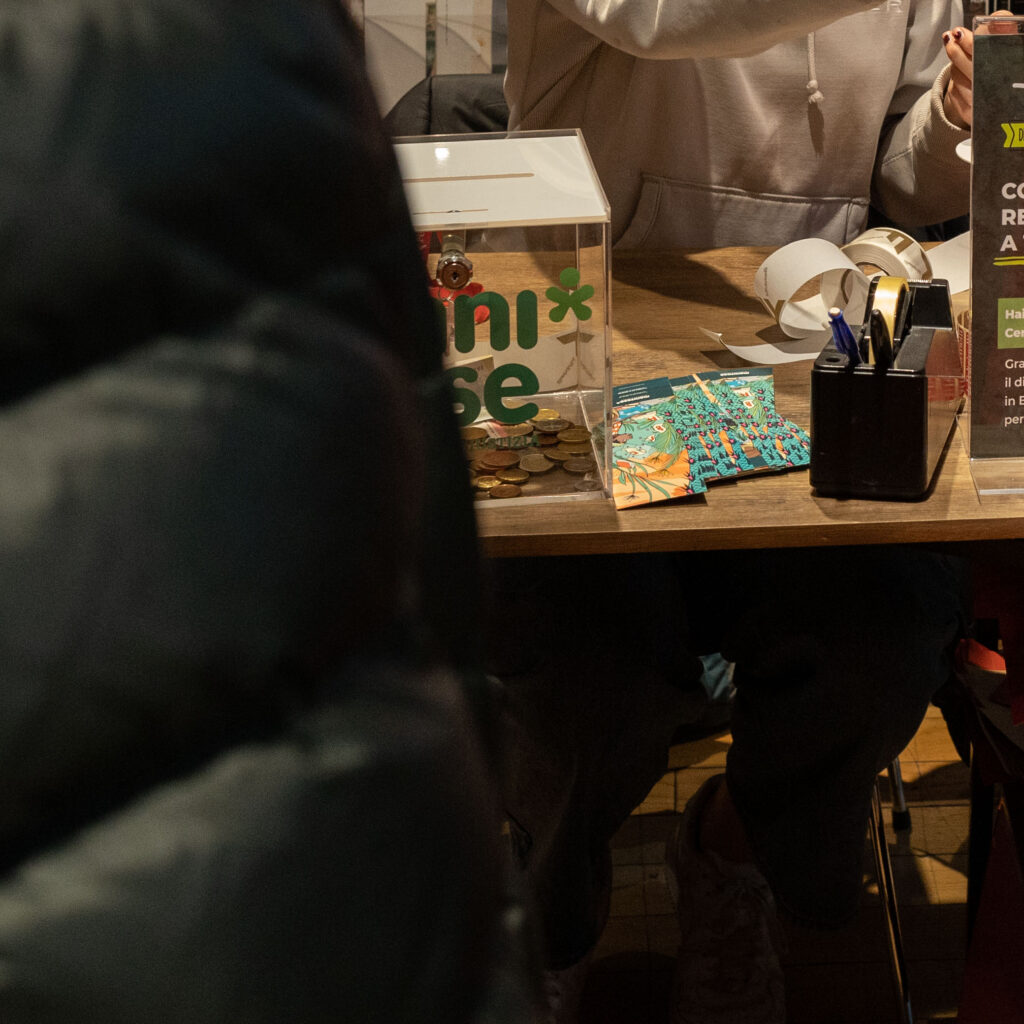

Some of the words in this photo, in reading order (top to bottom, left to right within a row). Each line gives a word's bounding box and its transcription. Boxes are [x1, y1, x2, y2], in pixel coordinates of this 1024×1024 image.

[1000, 234, 1017, 251] A
[438, 289, 538, 354] ni
[1005, 376, 1011, 387] il
[1005, 395, 1016, 406] in
